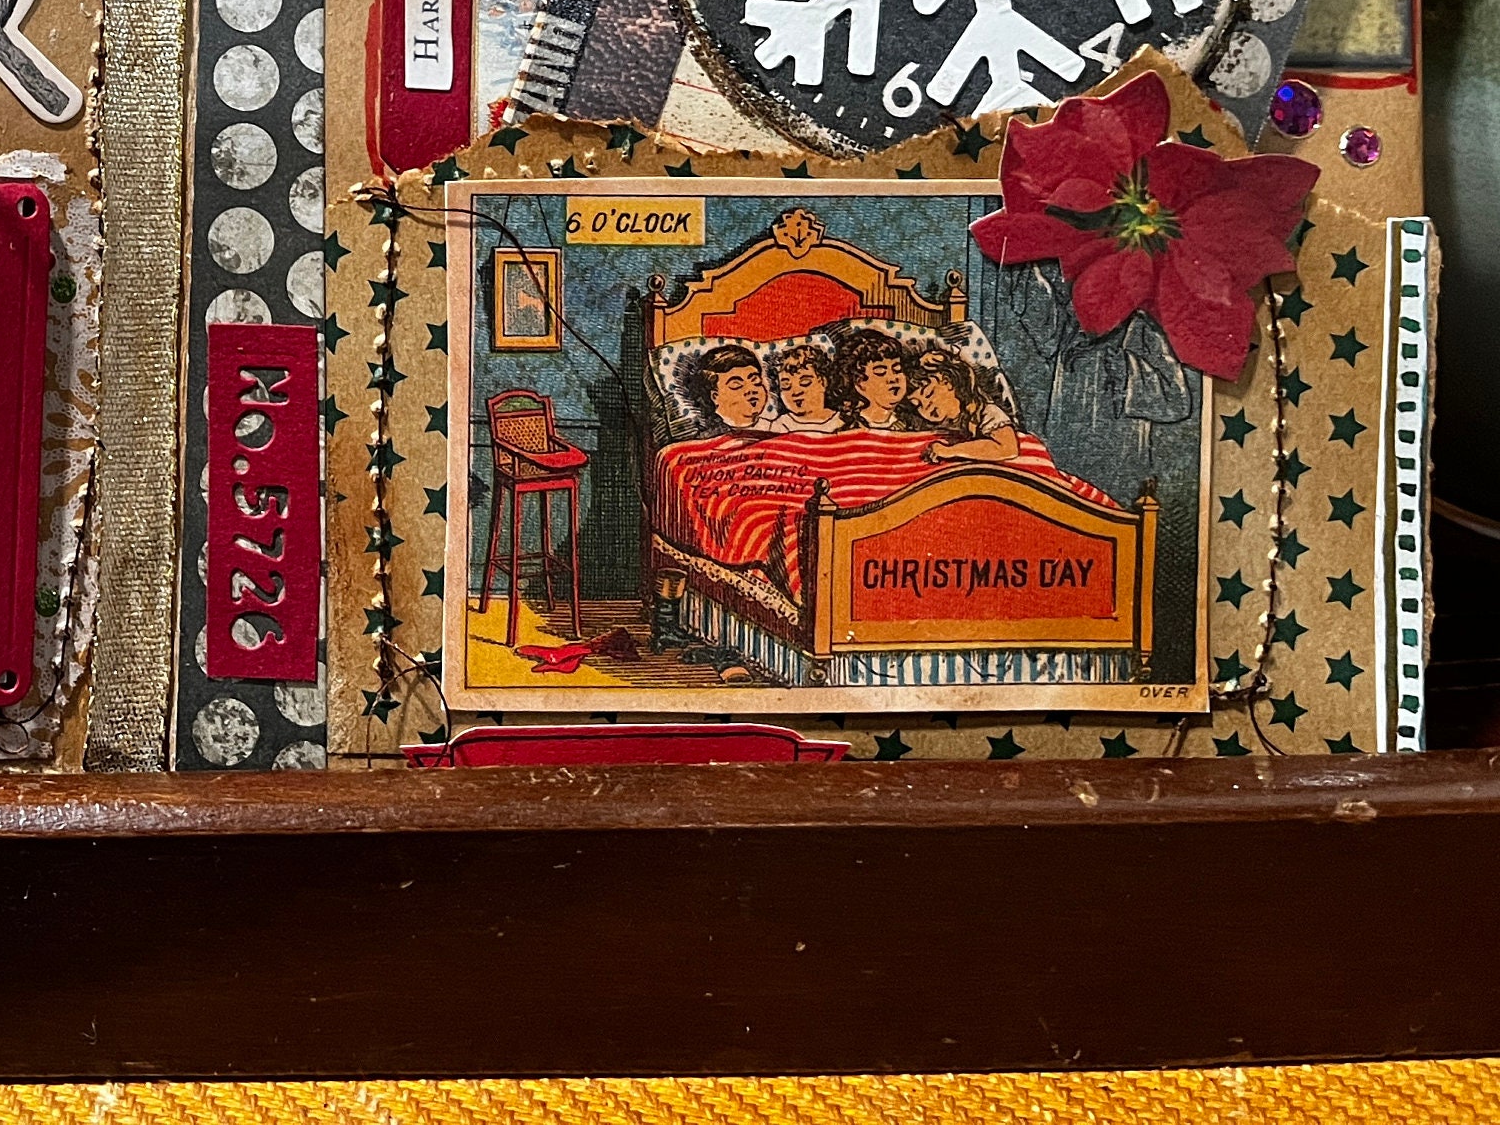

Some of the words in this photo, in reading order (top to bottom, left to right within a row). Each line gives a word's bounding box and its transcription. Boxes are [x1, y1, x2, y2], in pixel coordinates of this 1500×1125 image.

[1077, 22, 1126, 74] 4
[882, 61, 922, 118] 6
[565, 211, 582, 234] 6
[591, 208, 692, 234] O'CLOCK
[683, 465, 737, 483] UNION
[743, 464, 809, 480] PACIFIC
[690, 484, 721, 498] TEA
[727, 480, 811, 498] COMPANY
[862, 557, 1029, 598] CHRISTMAS
[1038, 557, 1095, 589] DAY
[1139, 686, 1189, 698] OVER
